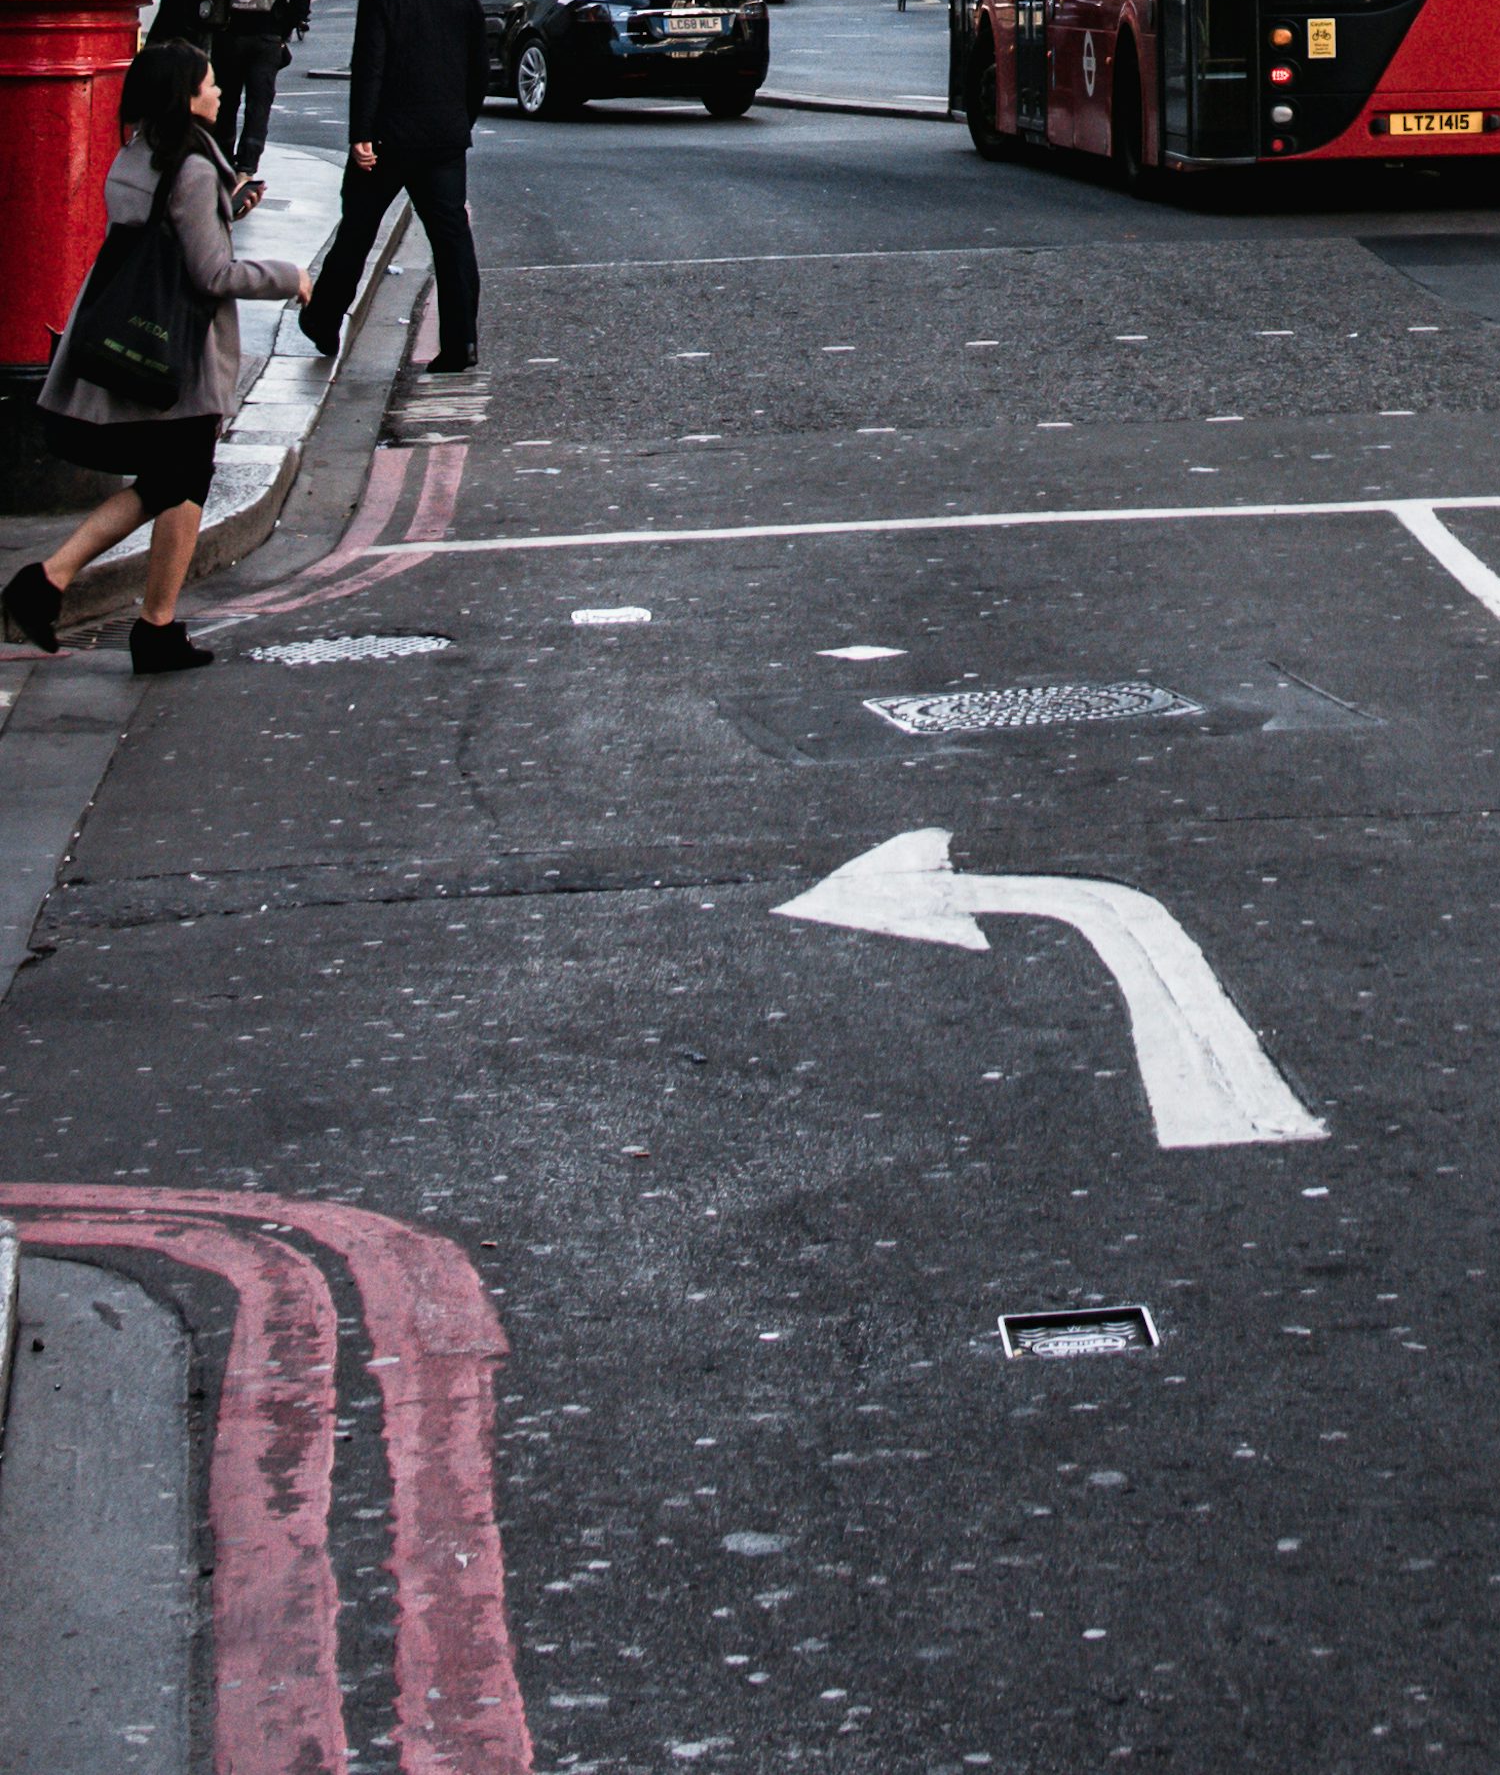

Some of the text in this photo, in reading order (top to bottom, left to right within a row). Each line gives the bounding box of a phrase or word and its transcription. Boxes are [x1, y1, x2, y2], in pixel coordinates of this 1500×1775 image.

[1402, 114, 1470, 131] LTZ 1415
[128, 315, 169, 343] AVEDA
